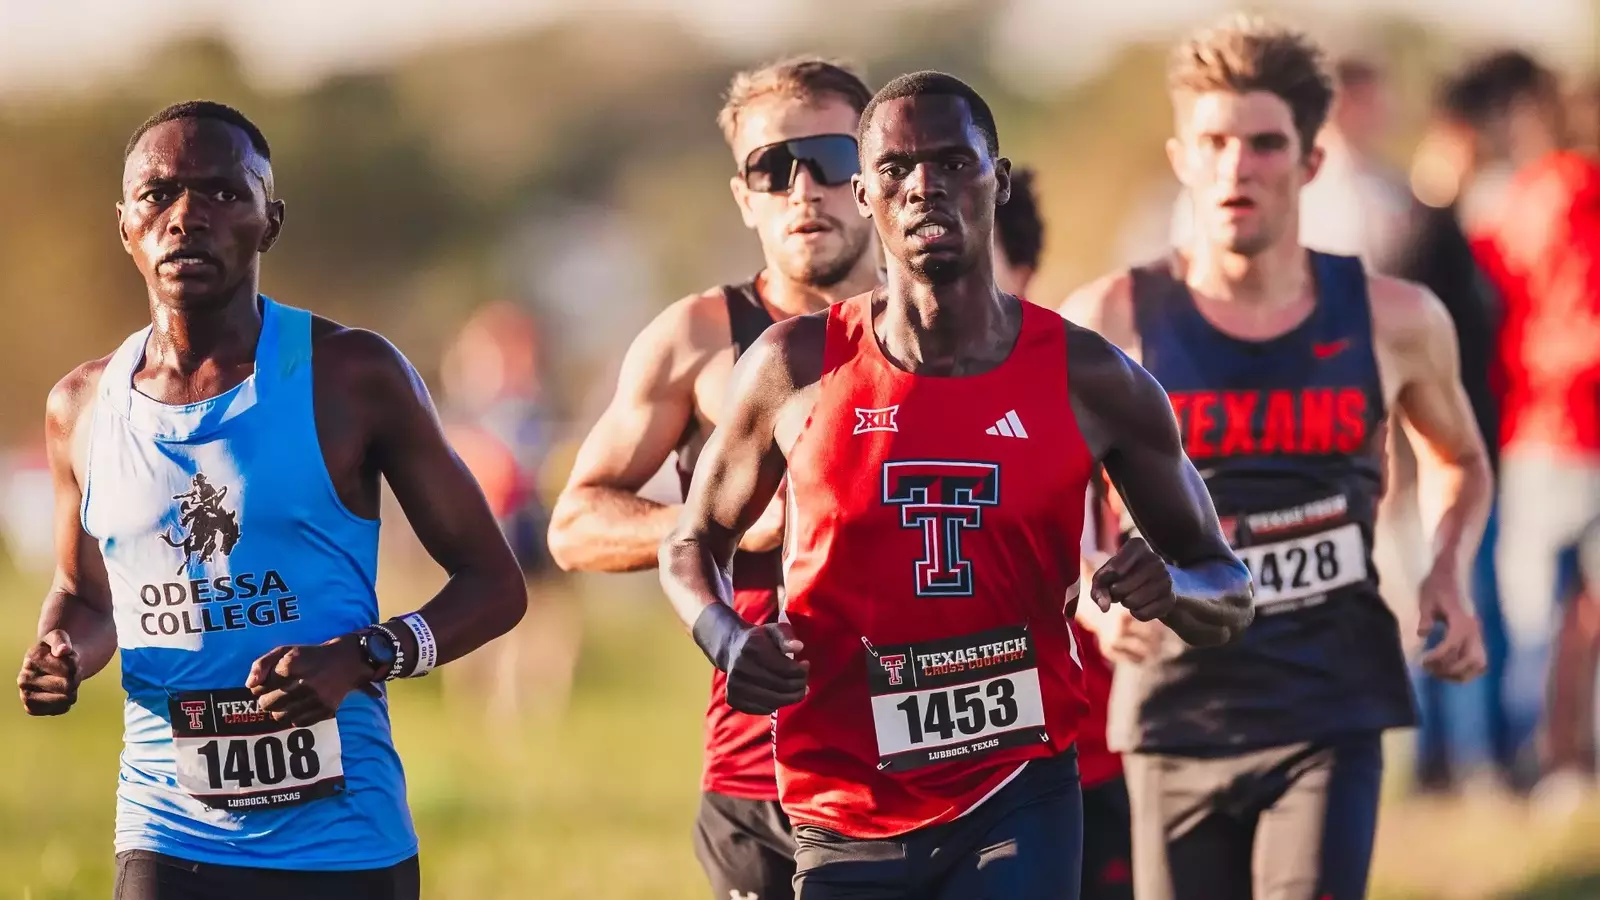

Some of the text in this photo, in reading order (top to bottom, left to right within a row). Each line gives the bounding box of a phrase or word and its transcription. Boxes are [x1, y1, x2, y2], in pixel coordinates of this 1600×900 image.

[1242, 540, 1339, 592] 428
[140, 570, 290, 607] ODESSA
[140, 596, 301, 635] COLLEGE
[412, 623, 425, 643] YEARS
[917, 637, 1028, 670] TEXAS TECH
[924, 650, 1025, 676] CROSS COUNTRY
[217, 700, 263, 717] TEX
[224, 712, 265, 724] CROSS
[896, 678, 1019, 744] 1453
[197, 728, 320, 789] 1408
[928, 738, 999, 761] LUBBOCK, TEXAS
[227, 791, 301, 807] LUBBOCK, TEXAS
